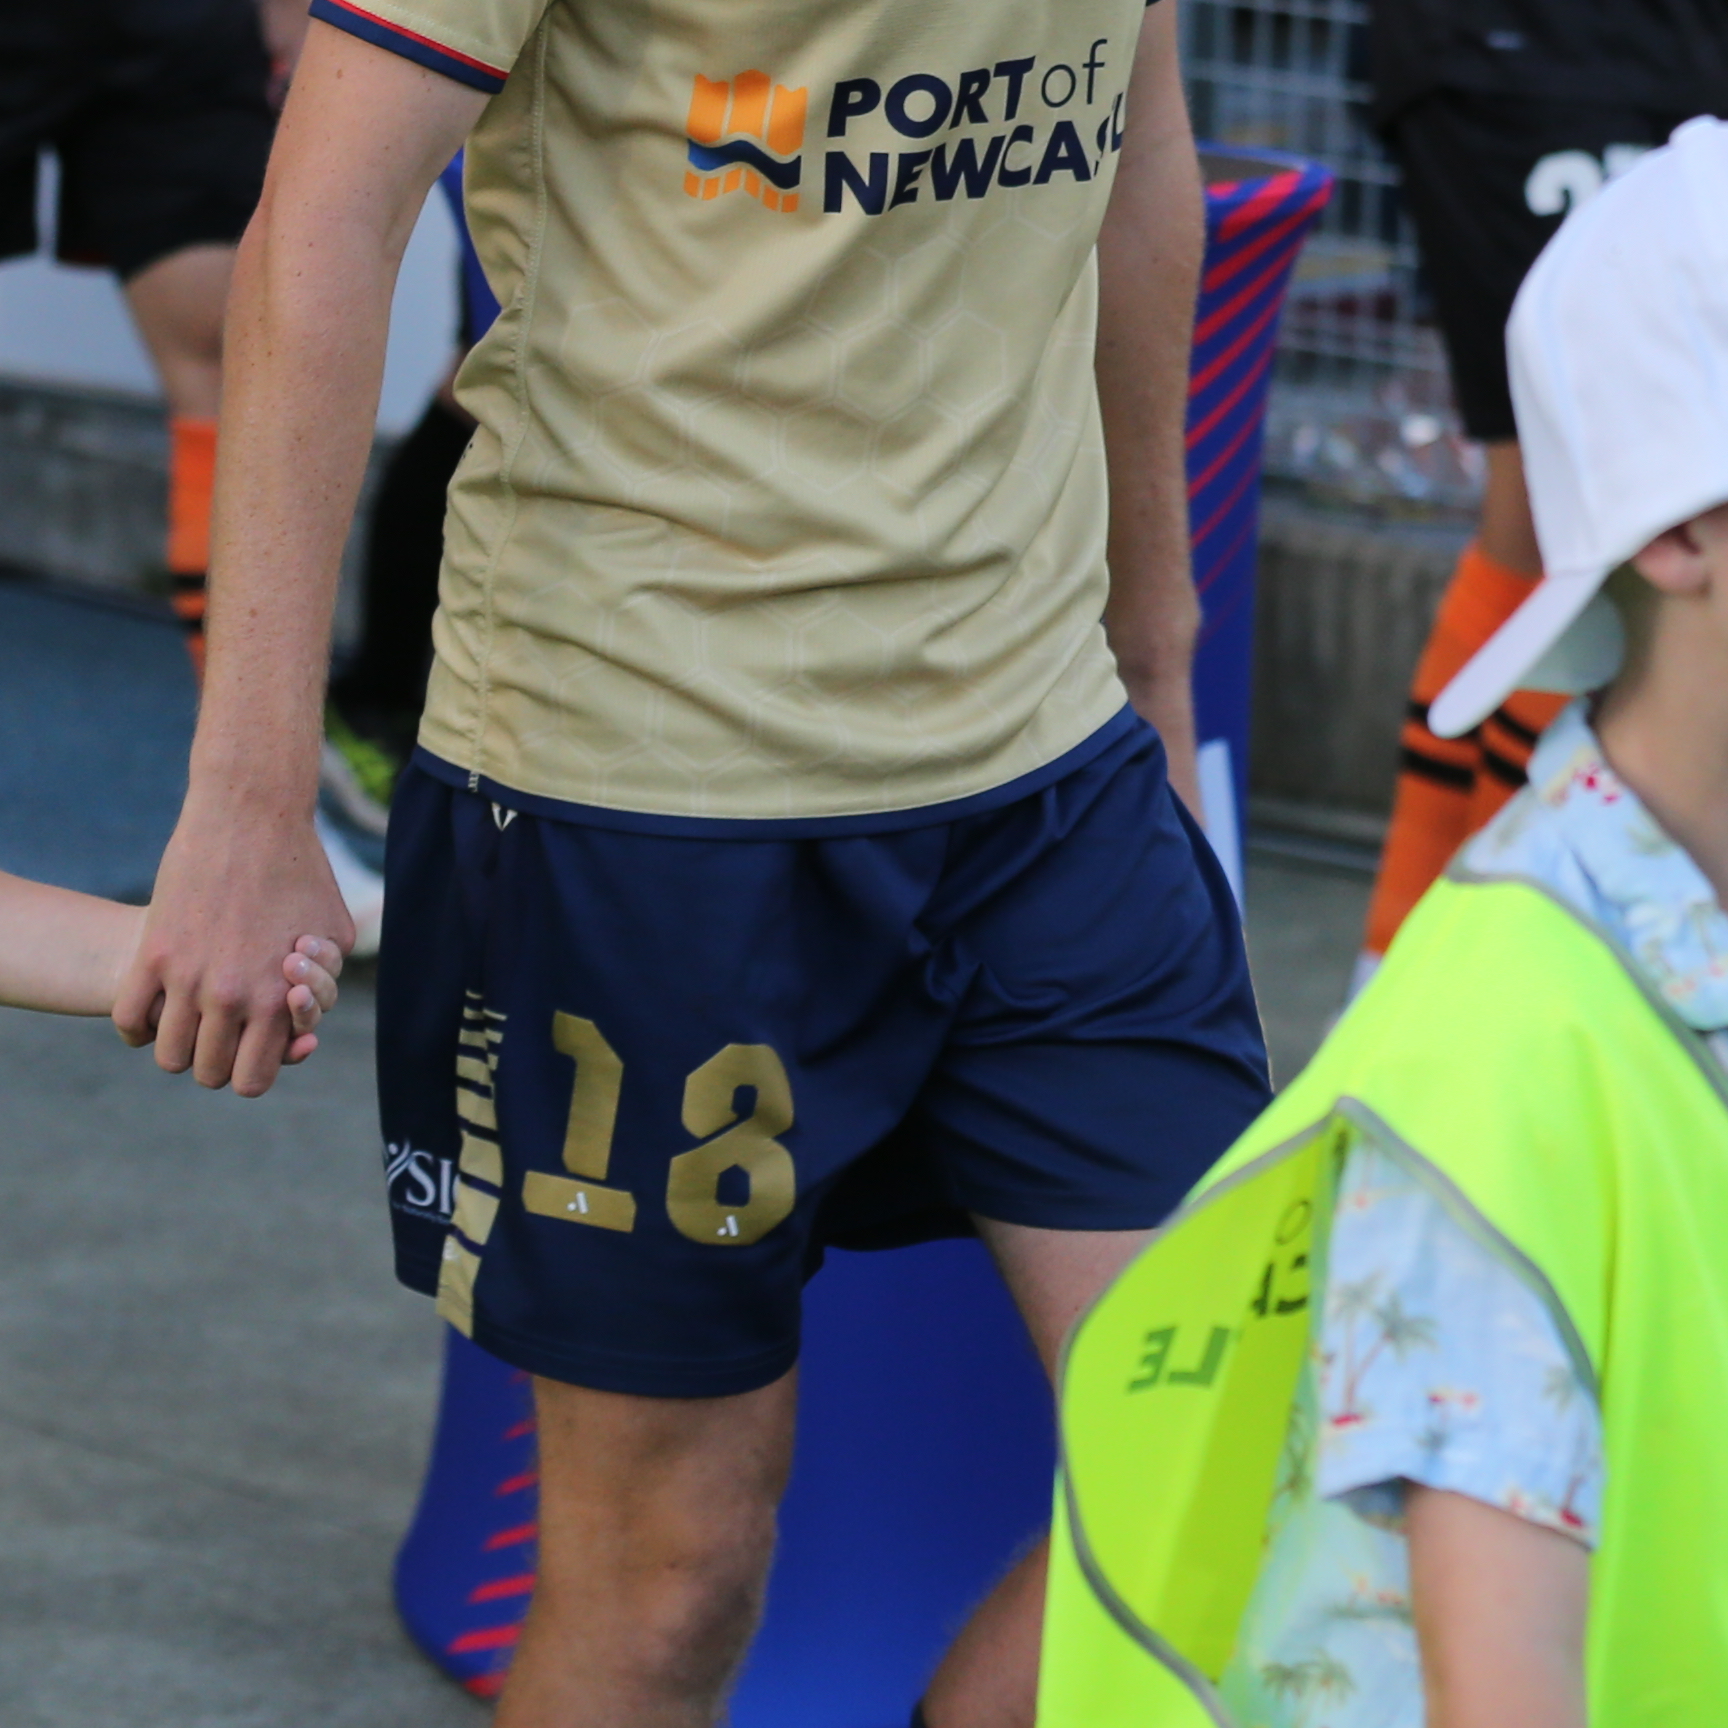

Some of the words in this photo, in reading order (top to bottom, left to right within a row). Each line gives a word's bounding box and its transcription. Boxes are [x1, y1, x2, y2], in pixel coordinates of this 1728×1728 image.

[827, 56, 1036, 138] PORT
[1041, 38, 1108, 108] of
[521, 1009, 796, 1246] 18
